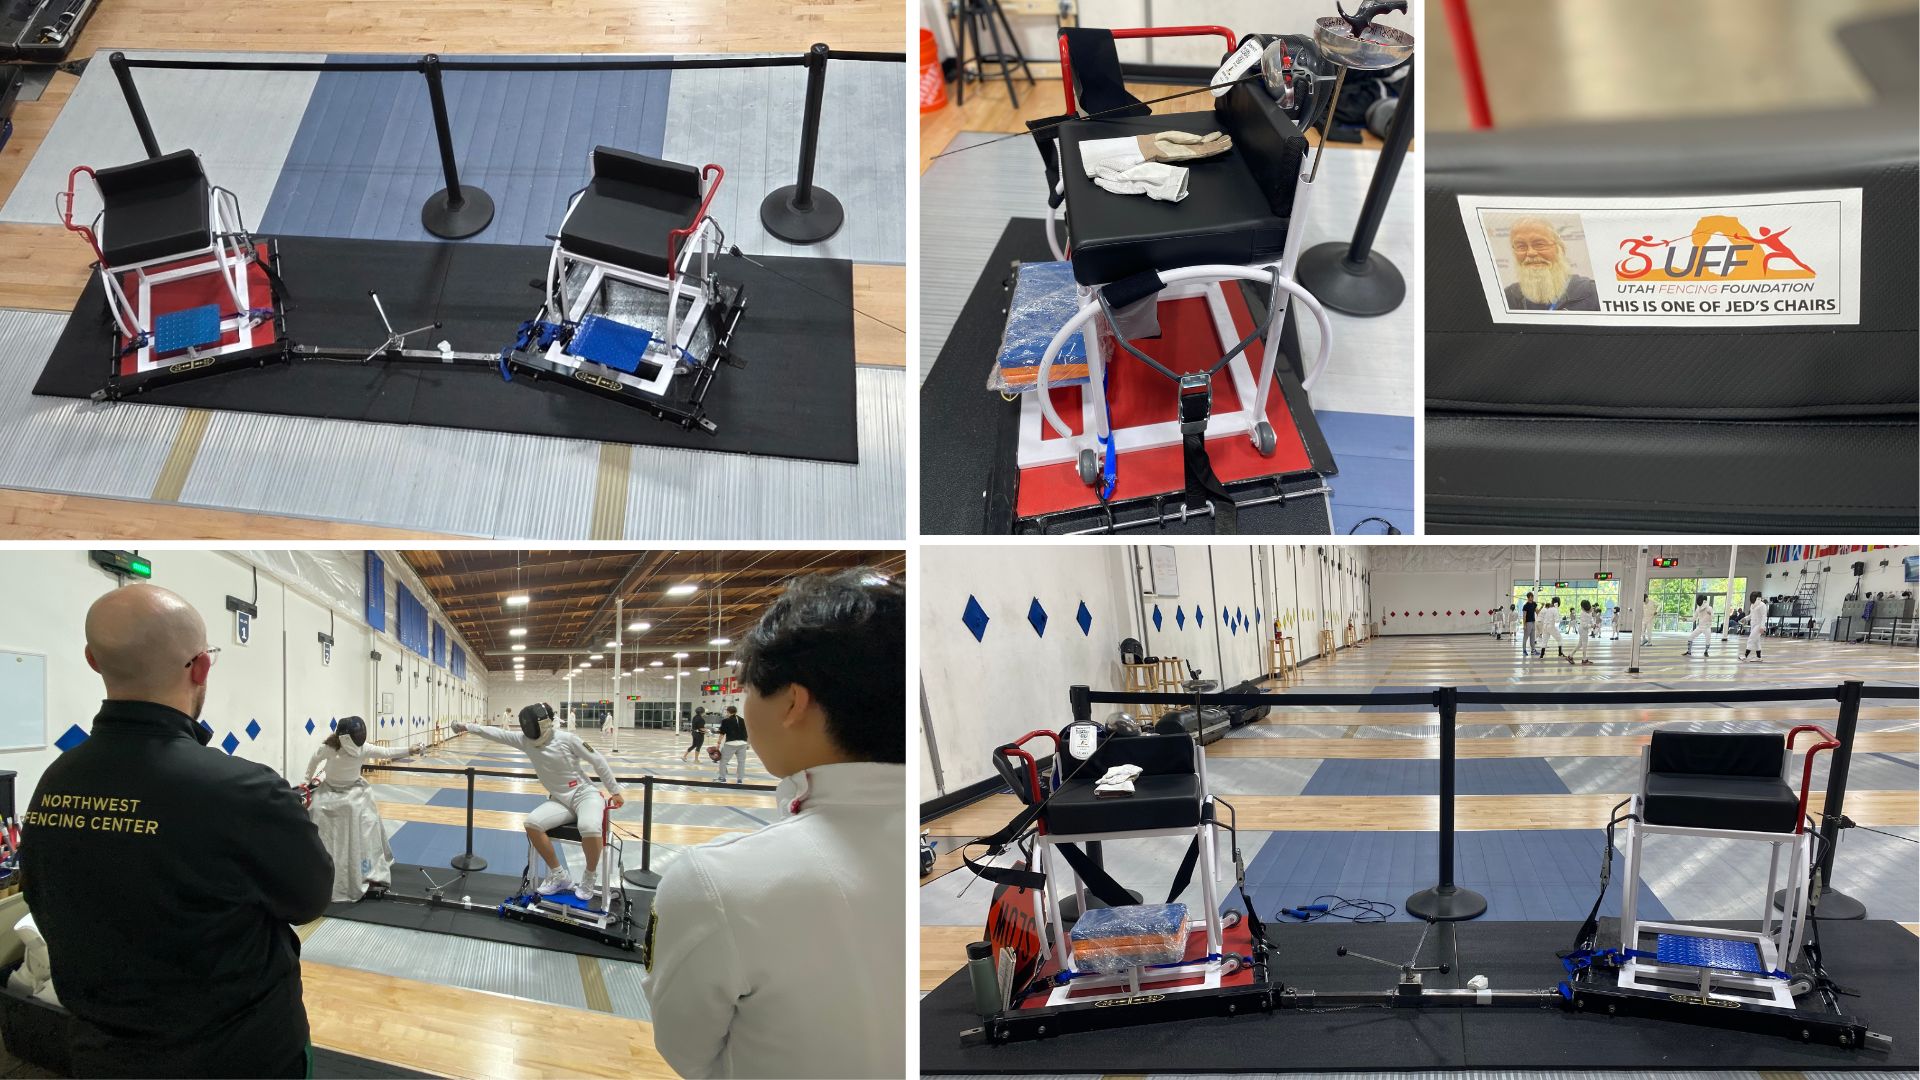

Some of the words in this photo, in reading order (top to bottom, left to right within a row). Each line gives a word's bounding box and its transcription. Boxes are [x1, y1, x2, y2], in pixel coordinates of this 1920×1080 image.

[1664, 244, 1755, 278] UFF
[1617, 284, 1656, 294] UTAH
[1658, 284, 1718, 294] FENCING
[1720, 282, 1815, 294] FOUNDATION
[1602, 300, 1639, 312] THIS
[1642, 300, 1657, 312] IS
[1661, 300, 1695, 313] ONE
[1699, 300, 1720, 313] OF
[1725, 300, 1769, 313] JED'S
[1773, 298, 1836, 312] CHAIRS
[241, 626, 247, 640] 1
[41, 794, 141, 813] NORTHWEST
[25, 811, 86, 829] FENCING
[90, 816, 159, 835] CENTER
